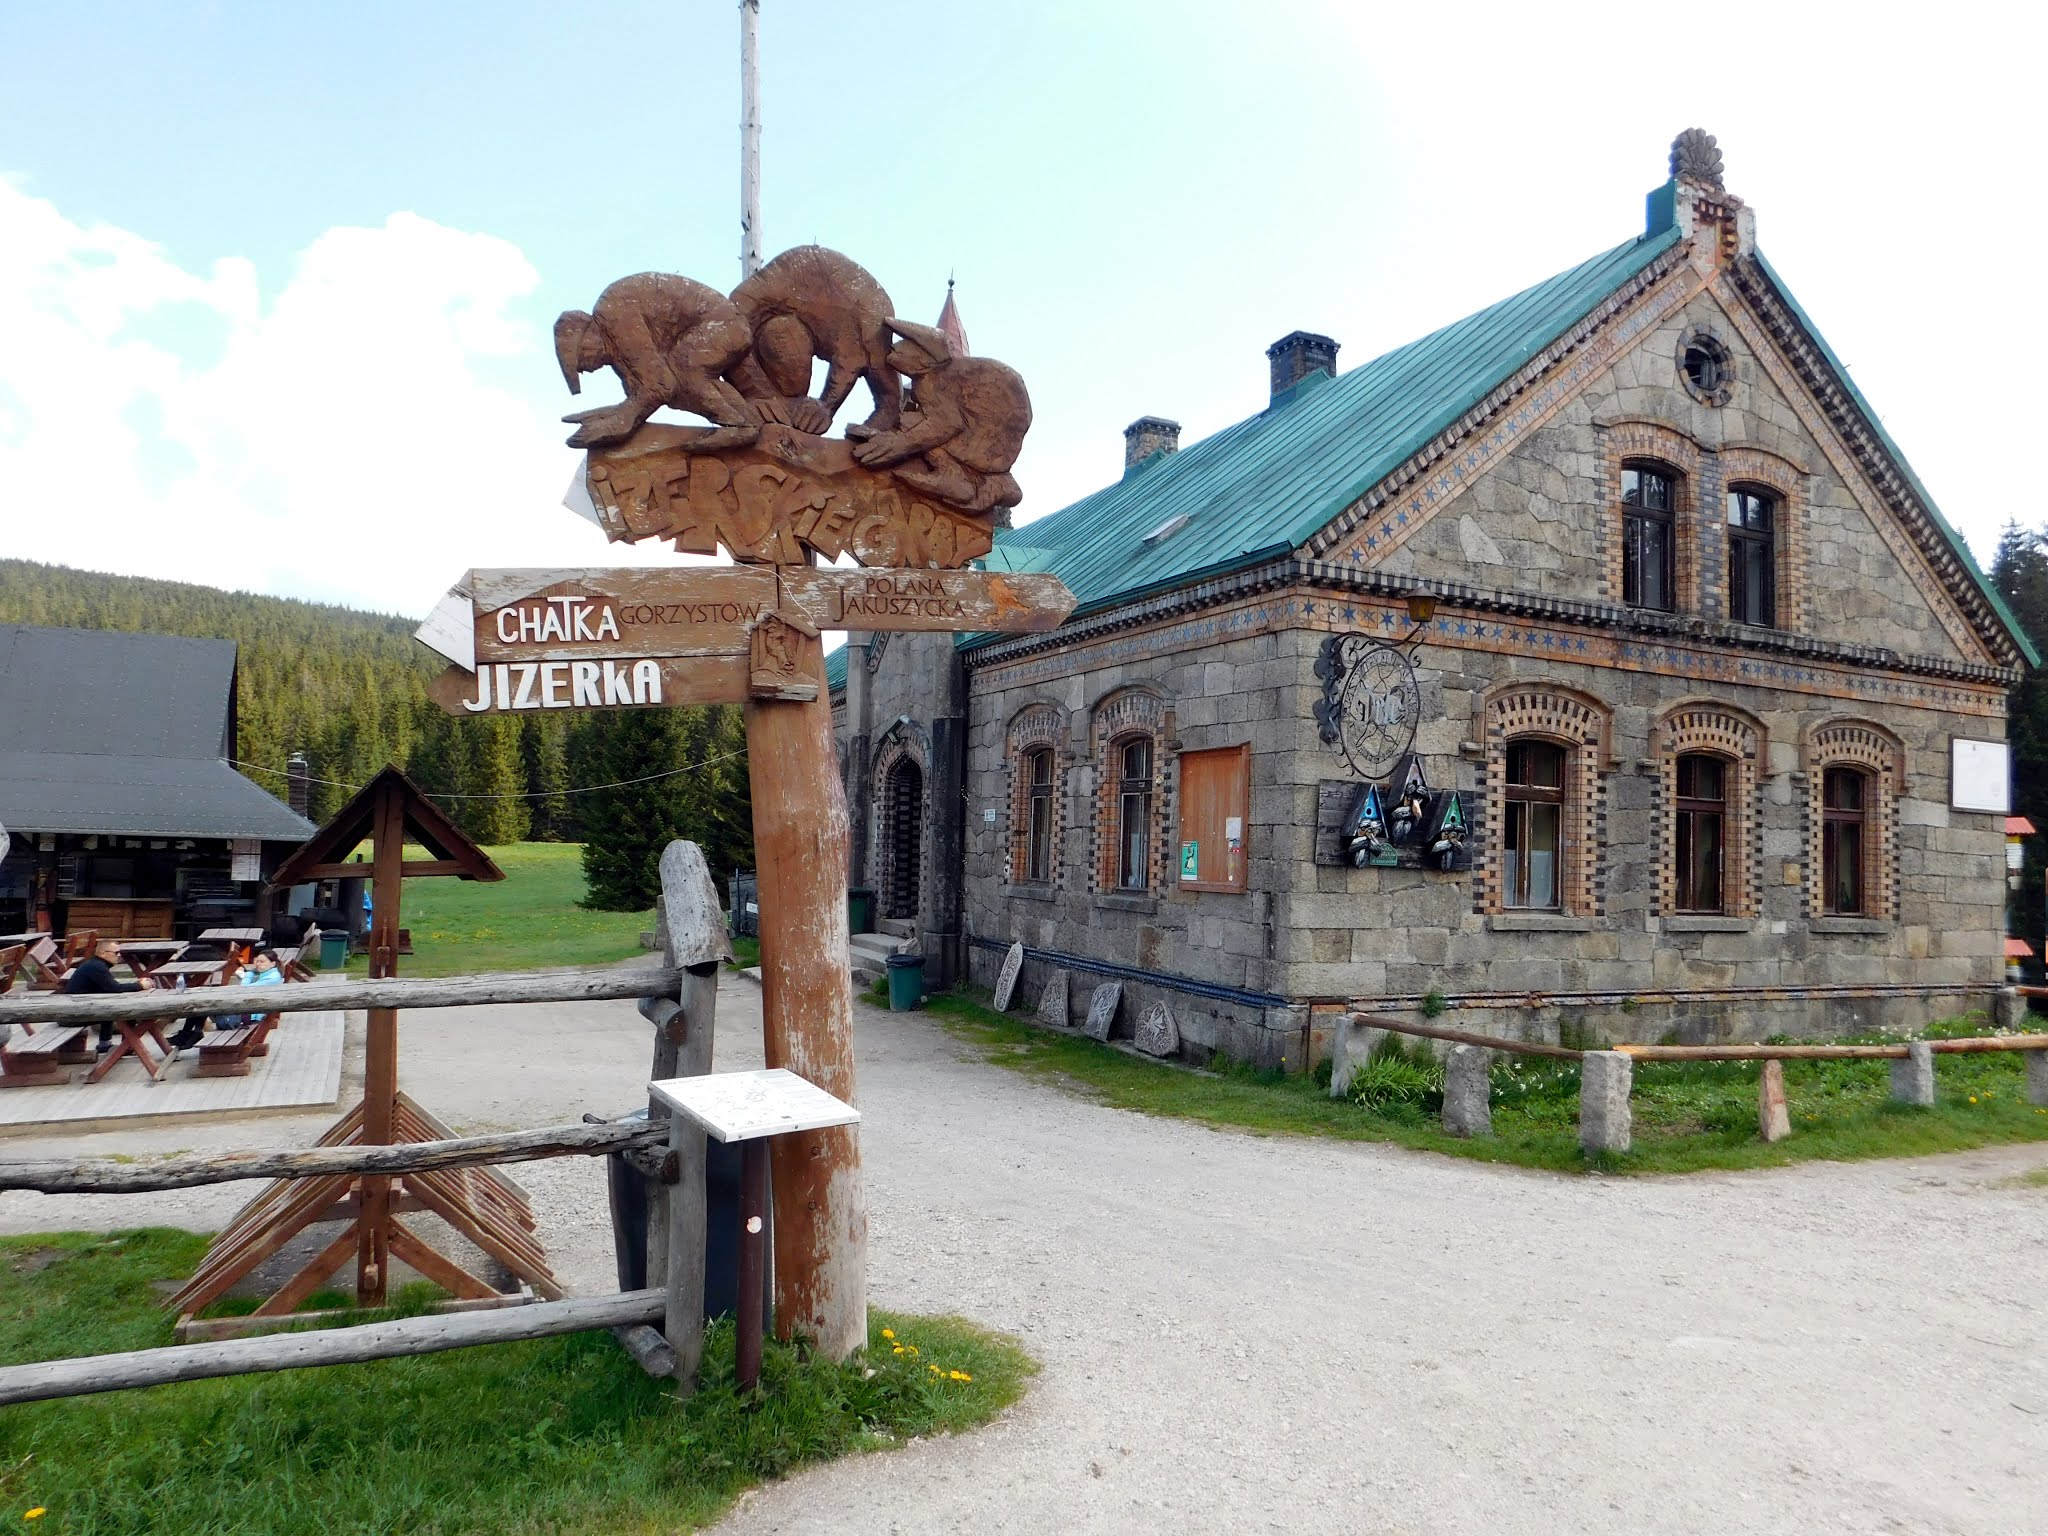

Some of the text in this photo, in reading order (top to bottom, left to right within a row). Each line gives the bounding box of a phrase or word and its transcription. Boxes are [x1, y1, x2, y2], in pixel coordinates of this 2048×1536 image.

[833, 585, 967, 622] JAKUSZYCKA
[866, 577, 947, 595] POLANA
[497, 596, 620, 643] CHATKA
